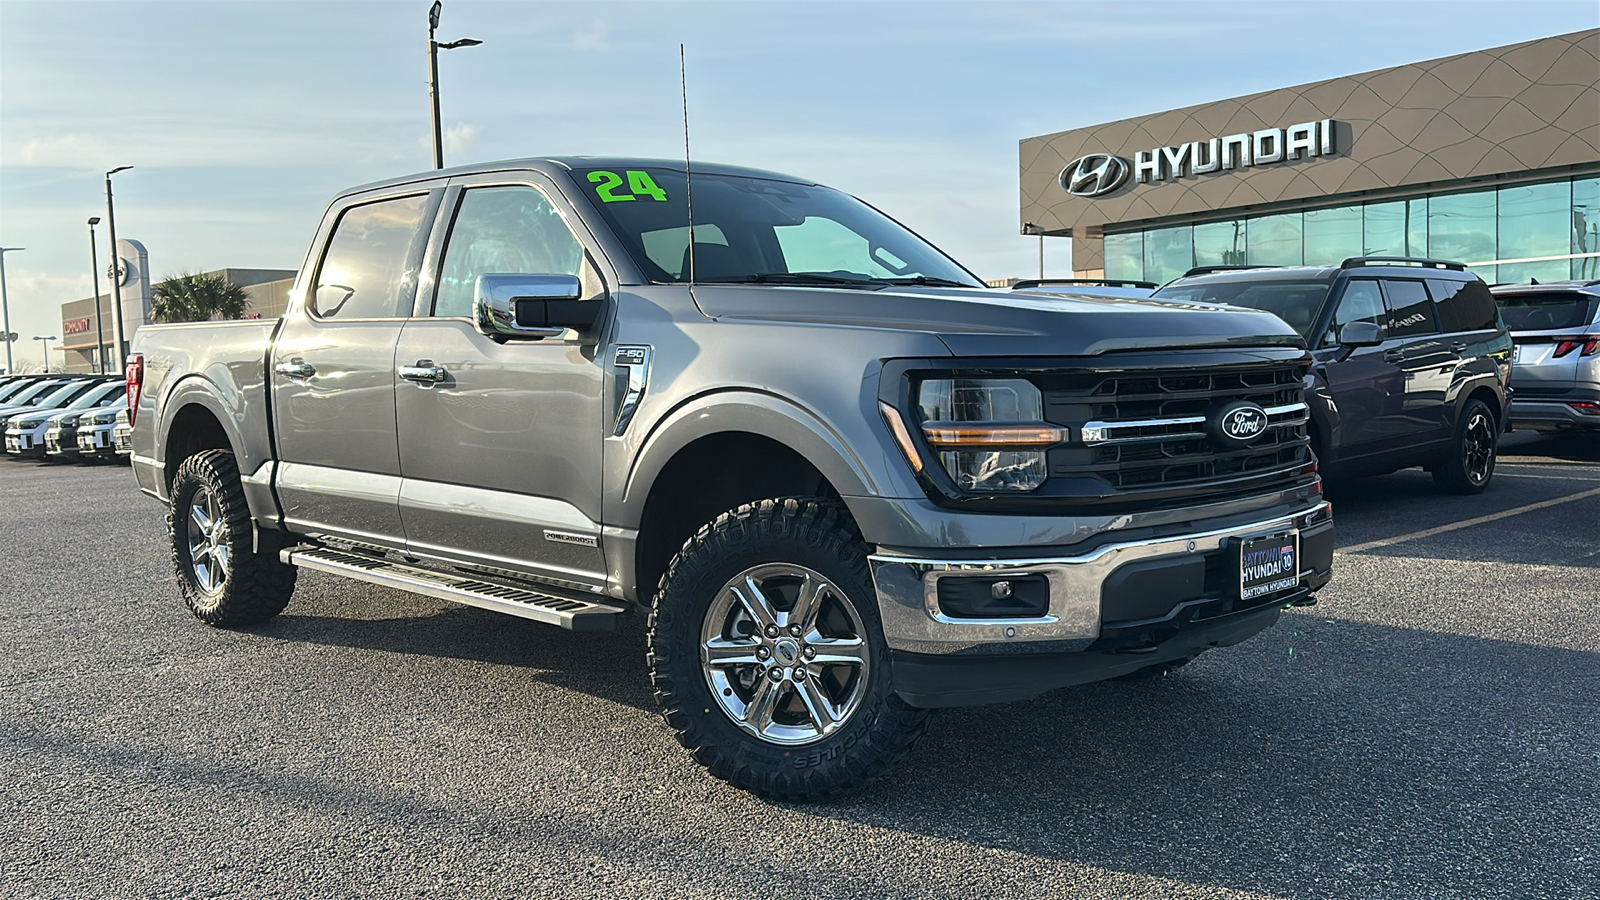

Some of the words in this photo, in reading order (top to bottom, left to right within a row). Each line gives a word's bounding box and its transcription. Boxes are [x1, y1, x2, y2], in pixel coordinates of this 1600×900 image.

[1134, 119, 1335, 184] HYUNDAI
[586, 170, 668, 203] 24
[616, 349, 645, 358] F-150
[1231, 411, 1260, 434] Ford
[1241, 560, 1282, 583] HYUNDAI
[1283, 554, 1292, 568] 10
[1243, 584, 1269, 598] BAYTOWN
[1269, 579, 1292, 591] HYUNDAI
